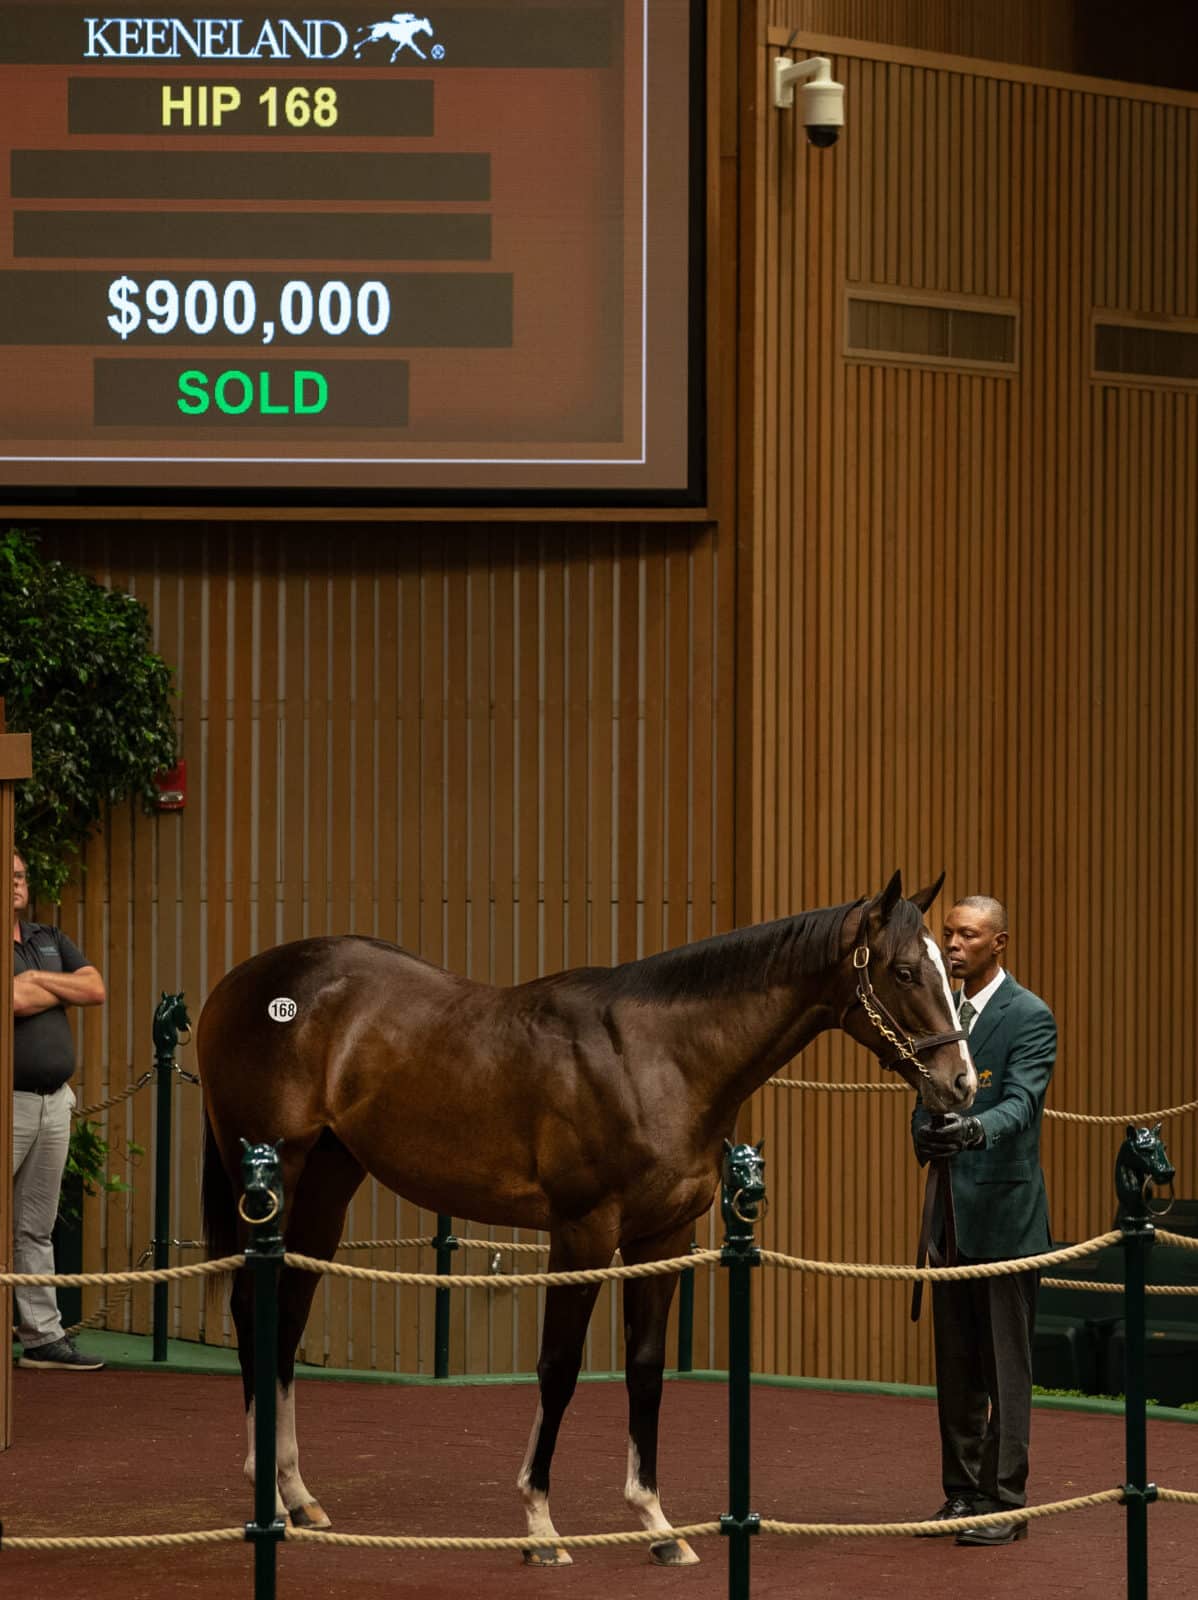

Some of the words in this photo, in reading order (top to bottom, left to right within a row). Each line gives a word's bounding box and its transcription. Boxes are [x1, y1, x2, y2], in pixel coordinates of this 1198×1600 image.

[83, 18, 348, 59] KEENELAND
[162, 86, 241, 127] HIP
[259, 86, 338, 127] 168
[107, 276, 391, 344] $900,000
[176, 370, 329, 414] SOLD
[271, 1002, 295, 1017] 168
